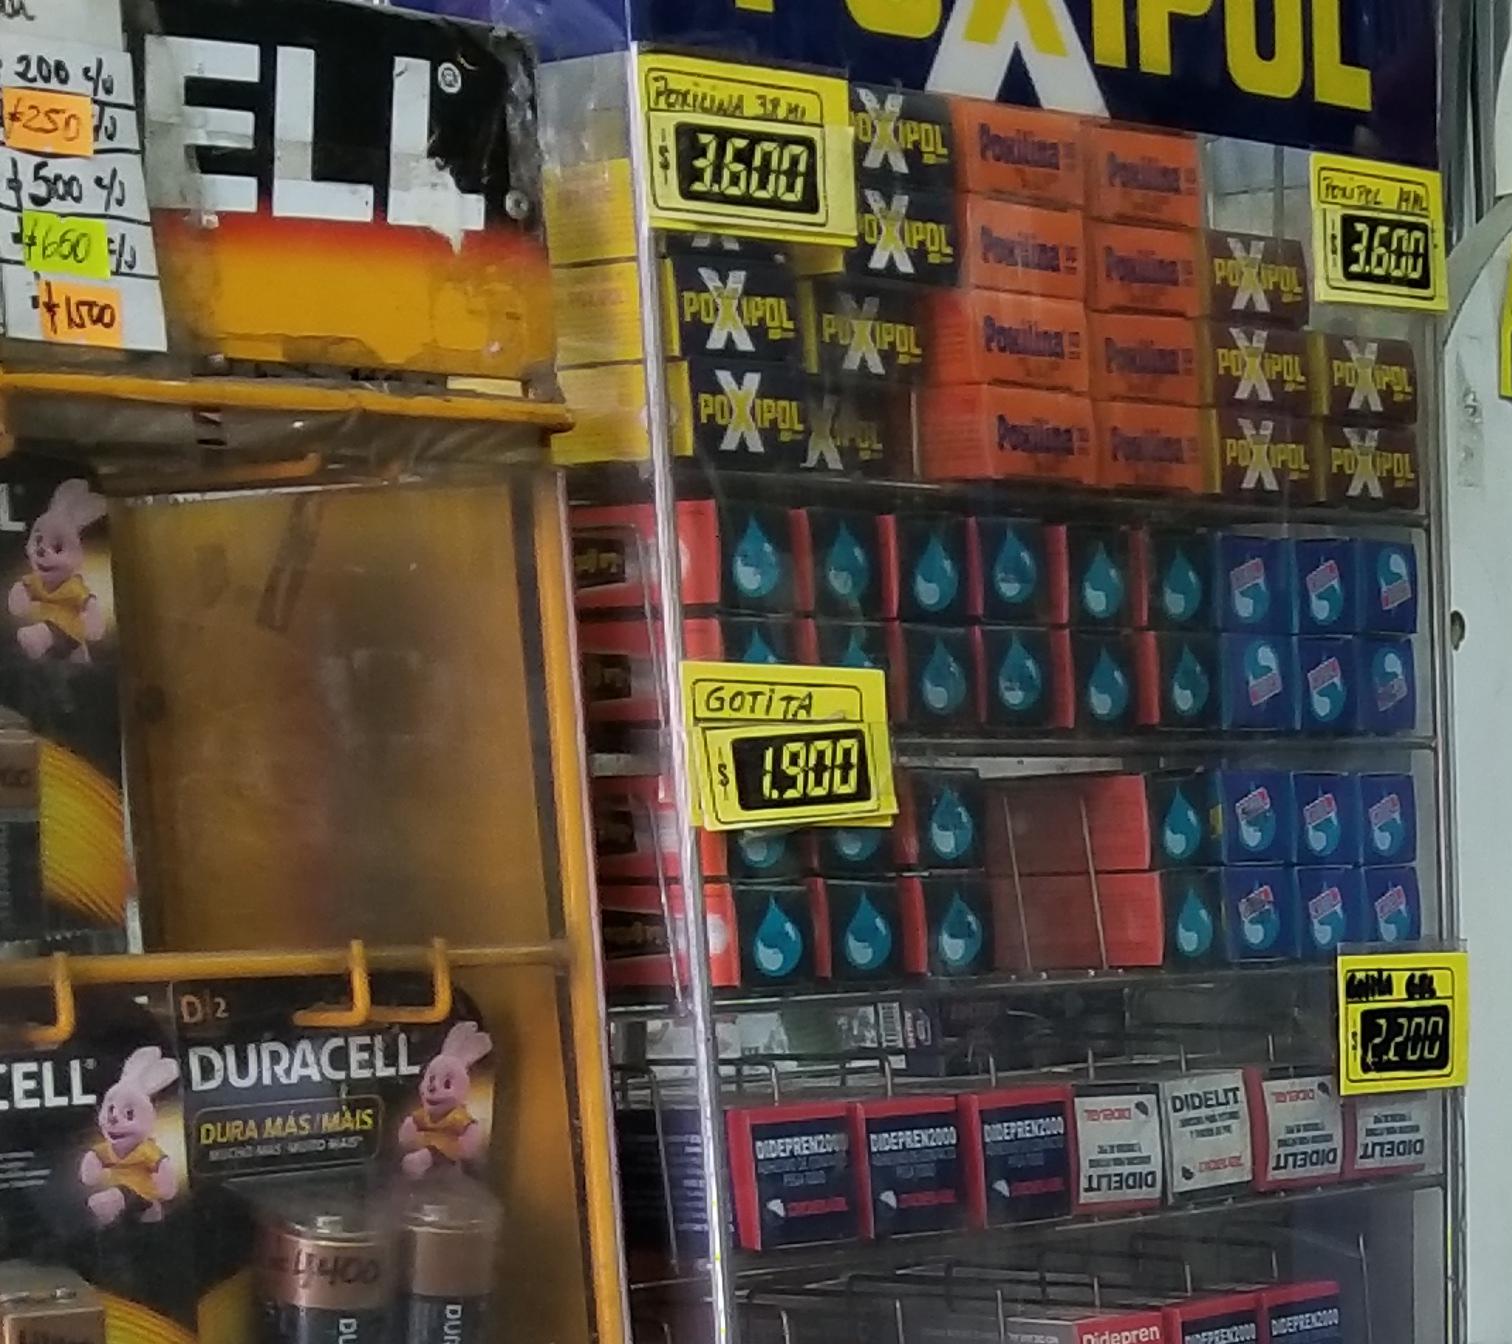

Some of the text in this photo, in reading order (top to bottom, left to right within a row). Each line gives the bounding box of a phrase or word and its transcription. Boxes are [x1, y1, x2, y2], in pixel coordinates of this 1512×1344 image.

[690, 132, 808, 201] 3.600
[1213, 237, 1304, 313] POXIPOL
[1349, 221, 1426, 280] 3.600
[682, 267, 796, 351] POXIPOL
[821, 290, 923, 375] POXIPOL
[1217, 327, 1306, 401] POXIPOL
[1332, 339, 1414, 412] POXIPOL
[698, 369, 804, 453] POXIPOL
[1225, 418, 1310, 491] POXIPOL
[1331, 427, 1415, 498] POXIPOL
[705, 684, 814, 720] GOTITA
[763, 738, 858, 800] 1.900
[188, 1030, 422, 1092] DURACELL
[1171, 1084, 1241, 1115] DIDELIT
[200, 1119, 258, 1146] DURA
[1271, 1146, 1339, 1173] DIDELIT
[1359, 1137, 1426, 1162] DIDELIT
[1082, 1168, 1158, 1195] DIDELIT
